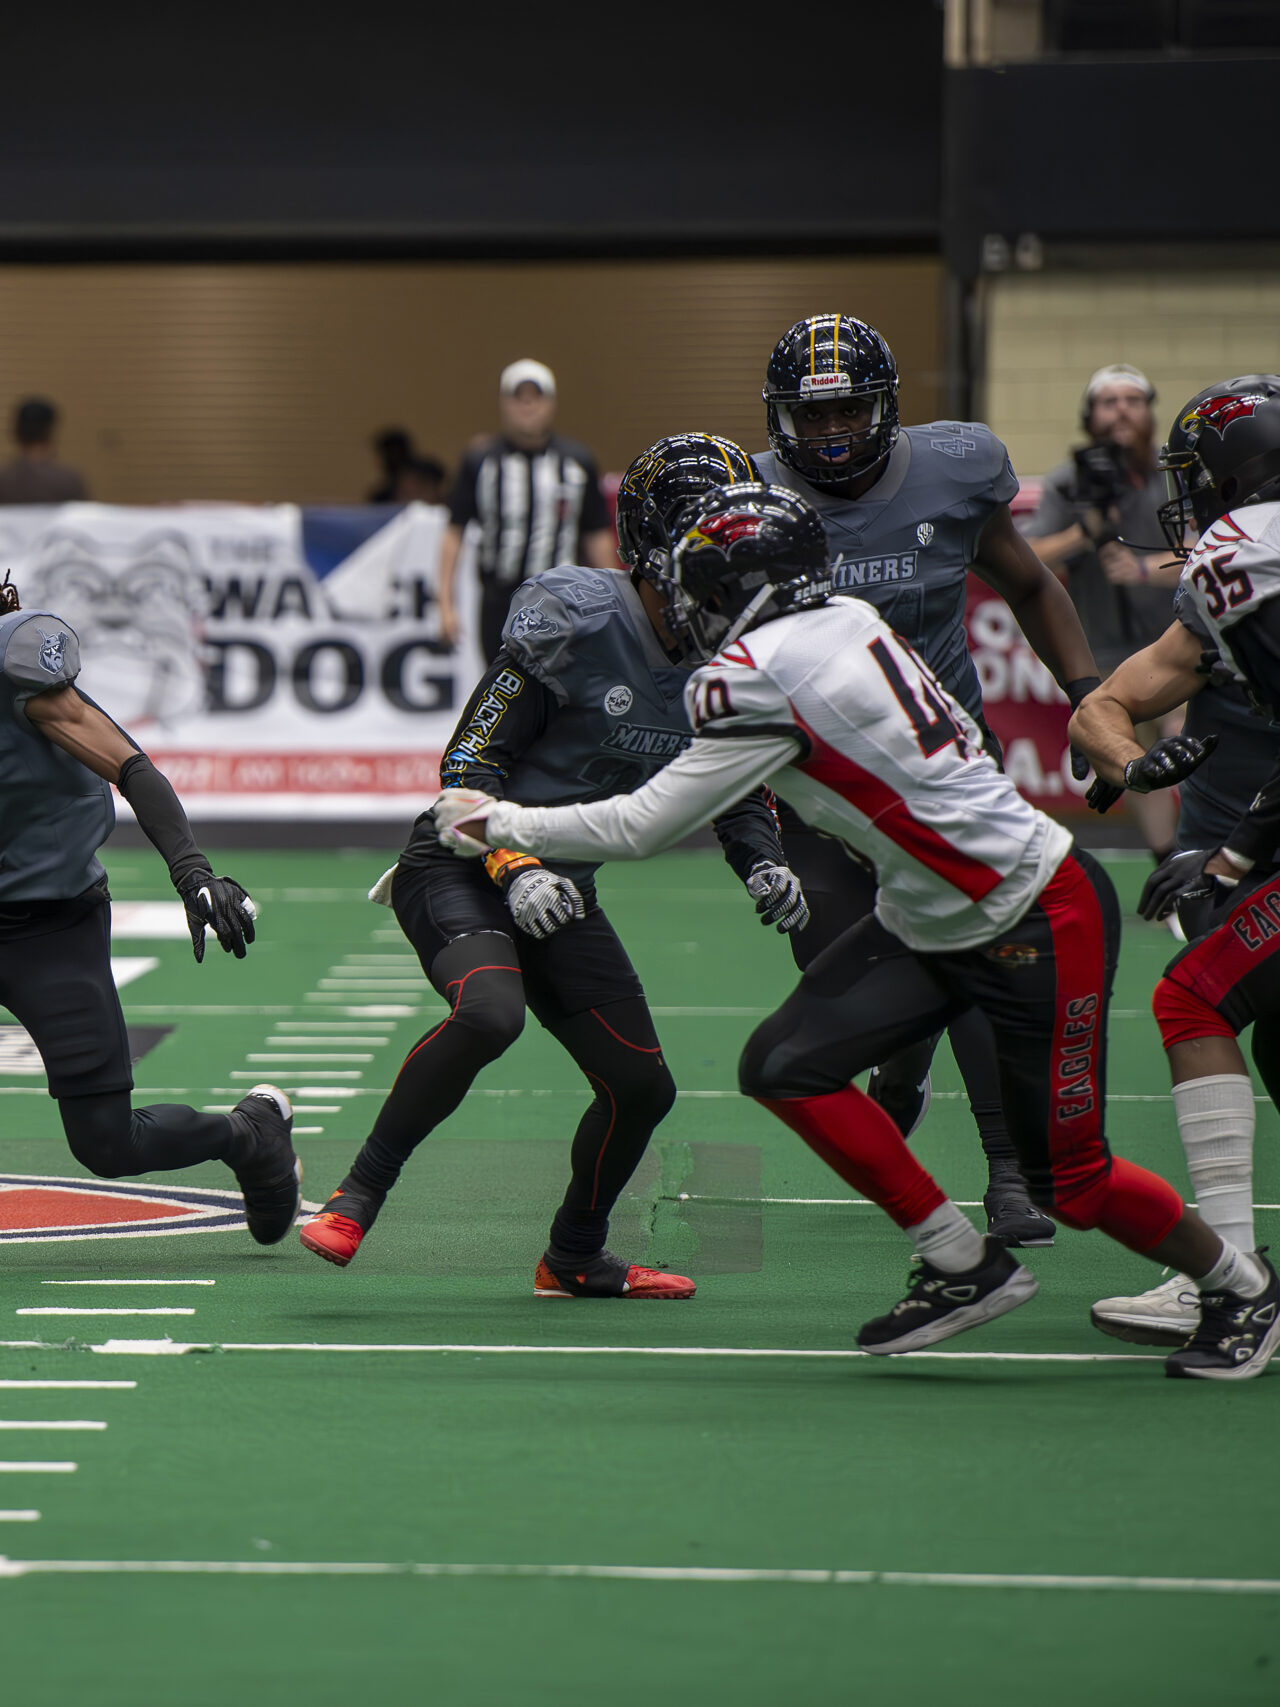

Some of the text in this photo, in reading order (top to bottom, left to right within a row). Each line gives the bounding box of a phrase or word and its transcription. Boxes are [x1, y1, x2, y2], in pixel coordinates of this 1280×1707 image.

[811, 375, 839, 386] Riddell
[832, 556, 914, 588] INERS
[1191, 551, 1254, 620] 35
[205, 638, 455, 713] DOG
[1057, 993, 1098, 1122] EAGLES
